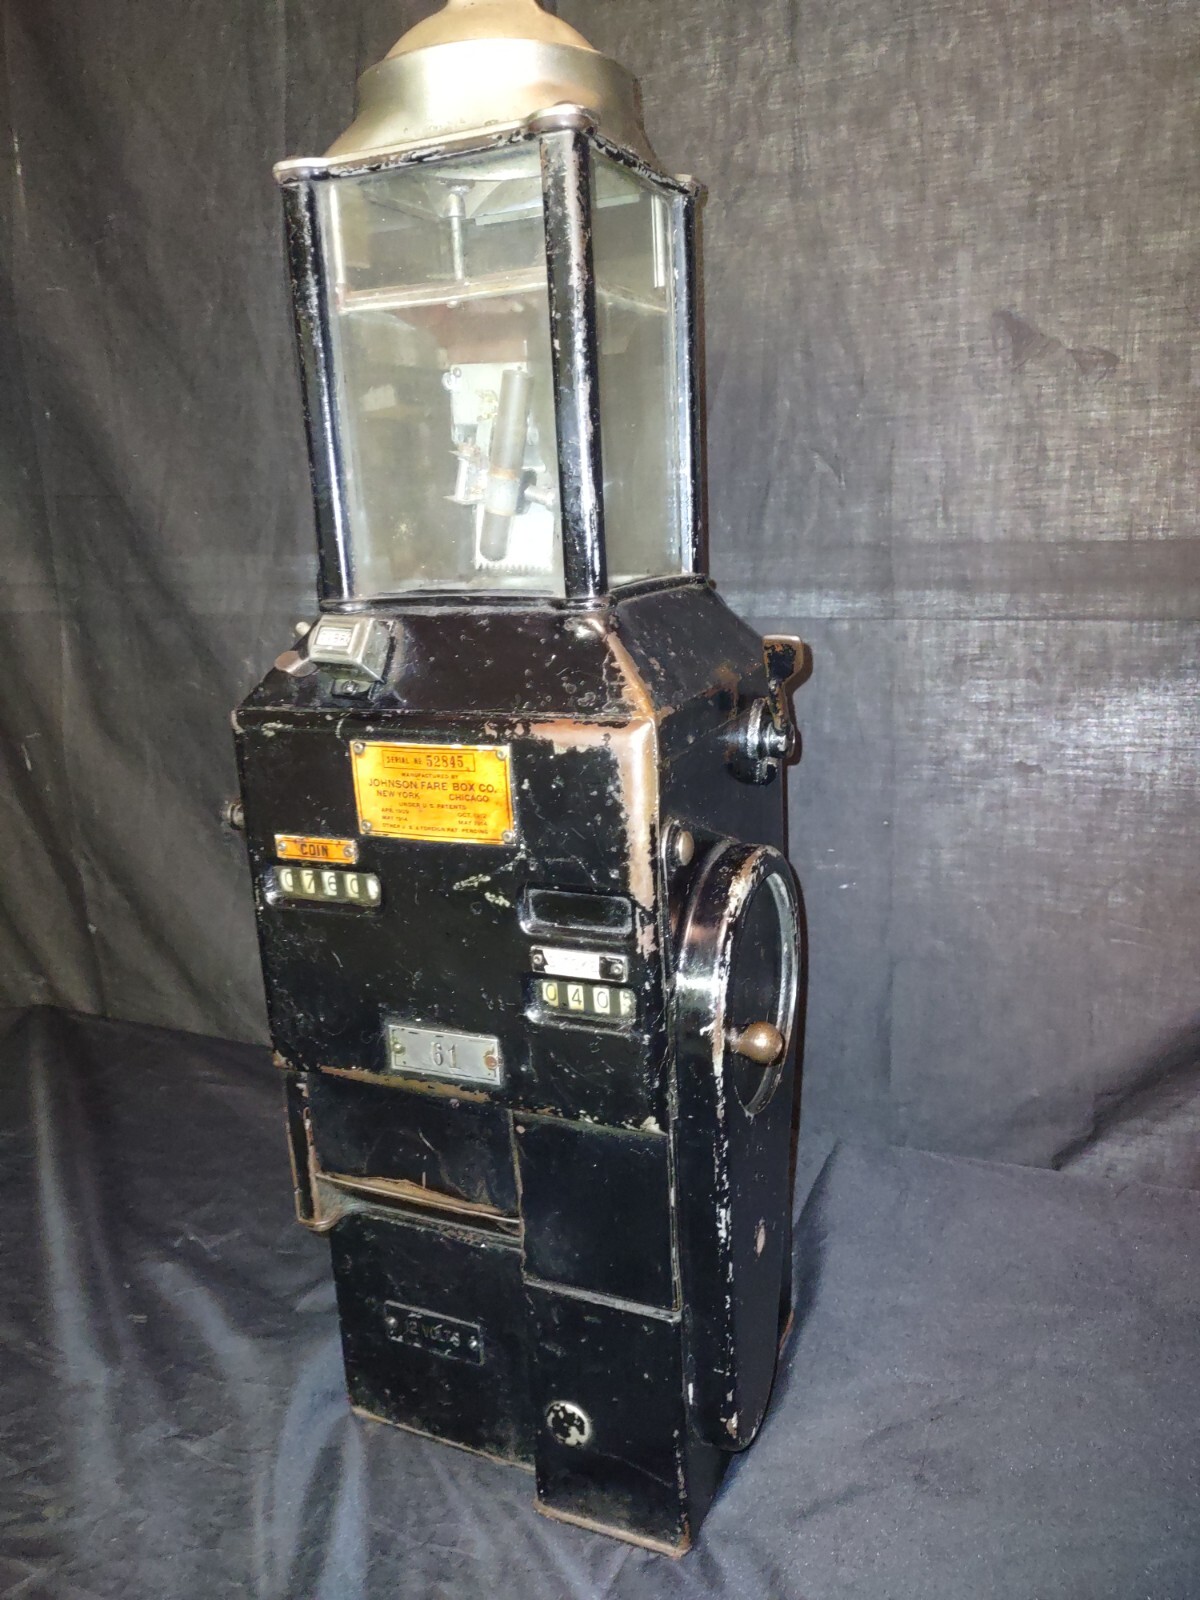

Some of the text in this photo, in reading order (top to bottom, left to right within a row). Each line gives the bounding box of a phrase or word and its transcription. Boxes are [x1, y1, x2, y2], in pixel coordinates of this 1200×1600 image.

[386, 756, 410, 764] SERIAL
[426, 755, 464, 768] 52845
[369, 778, 497, 794] JOHNSON FARE BOX CO.
[376, 790, 490, 803] NEW YORK CHICAGO
[436, 803, 467, 811] PATENTS
[300, 843, 329, 857] COIN
[432, 1041, 458, 1069] 61
